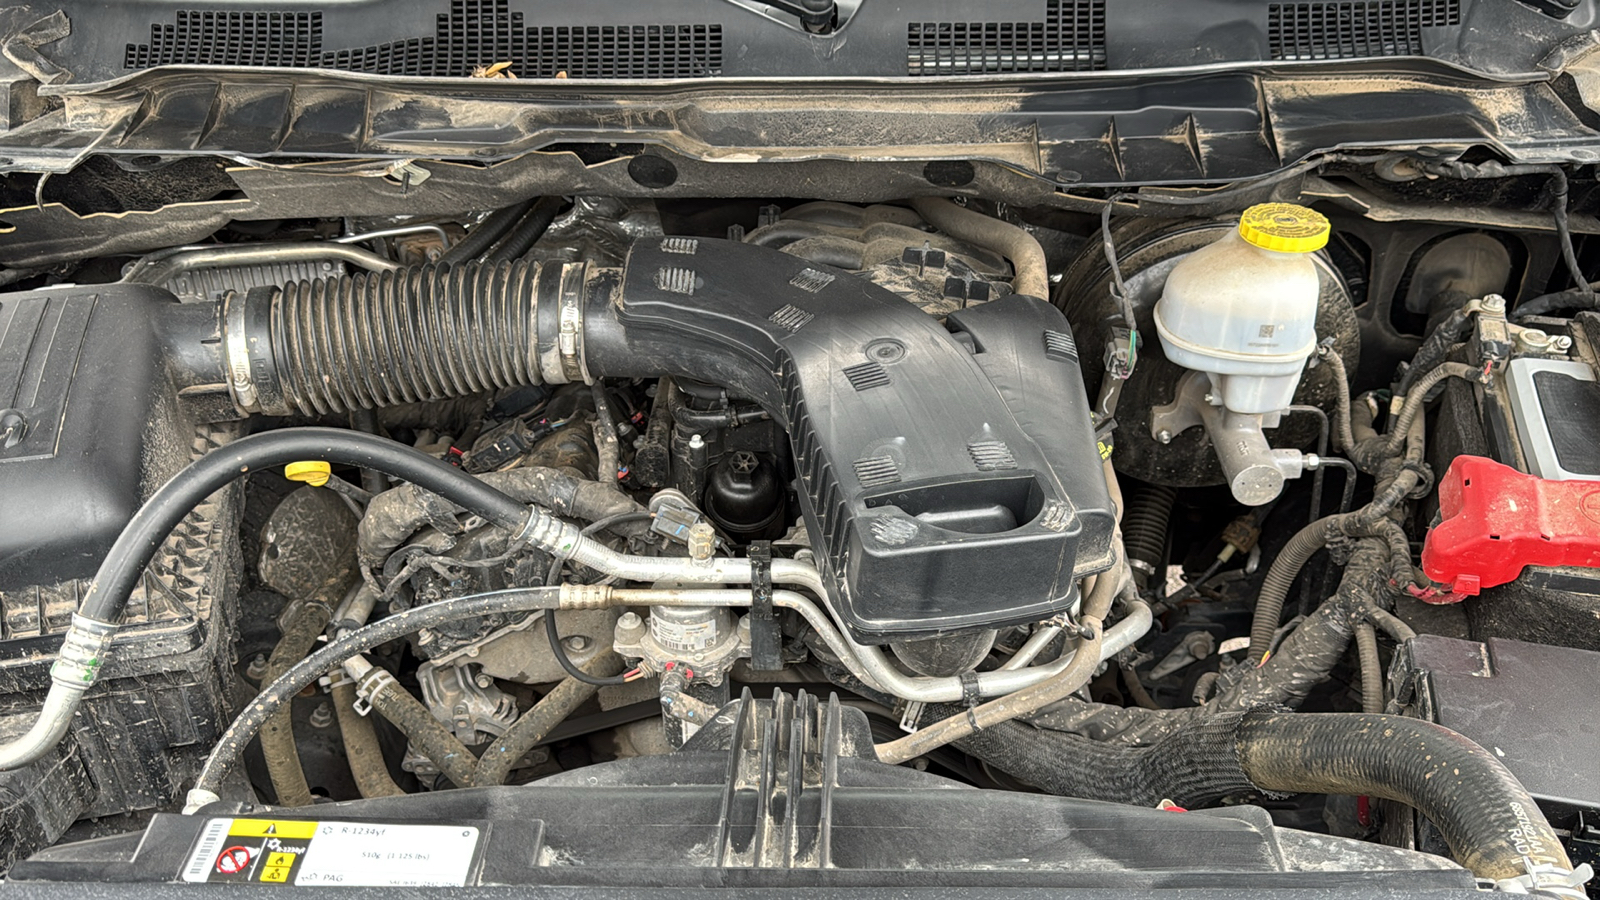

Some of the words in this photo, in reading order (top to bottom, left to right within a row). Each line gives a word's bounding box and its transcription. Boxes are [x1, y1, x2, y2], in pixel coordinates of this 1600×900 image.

[341, 827, 386, 837] R-1234yf
[1508, 828, 1531, 855] RAD
[323, 874, 344, 882] PAG
